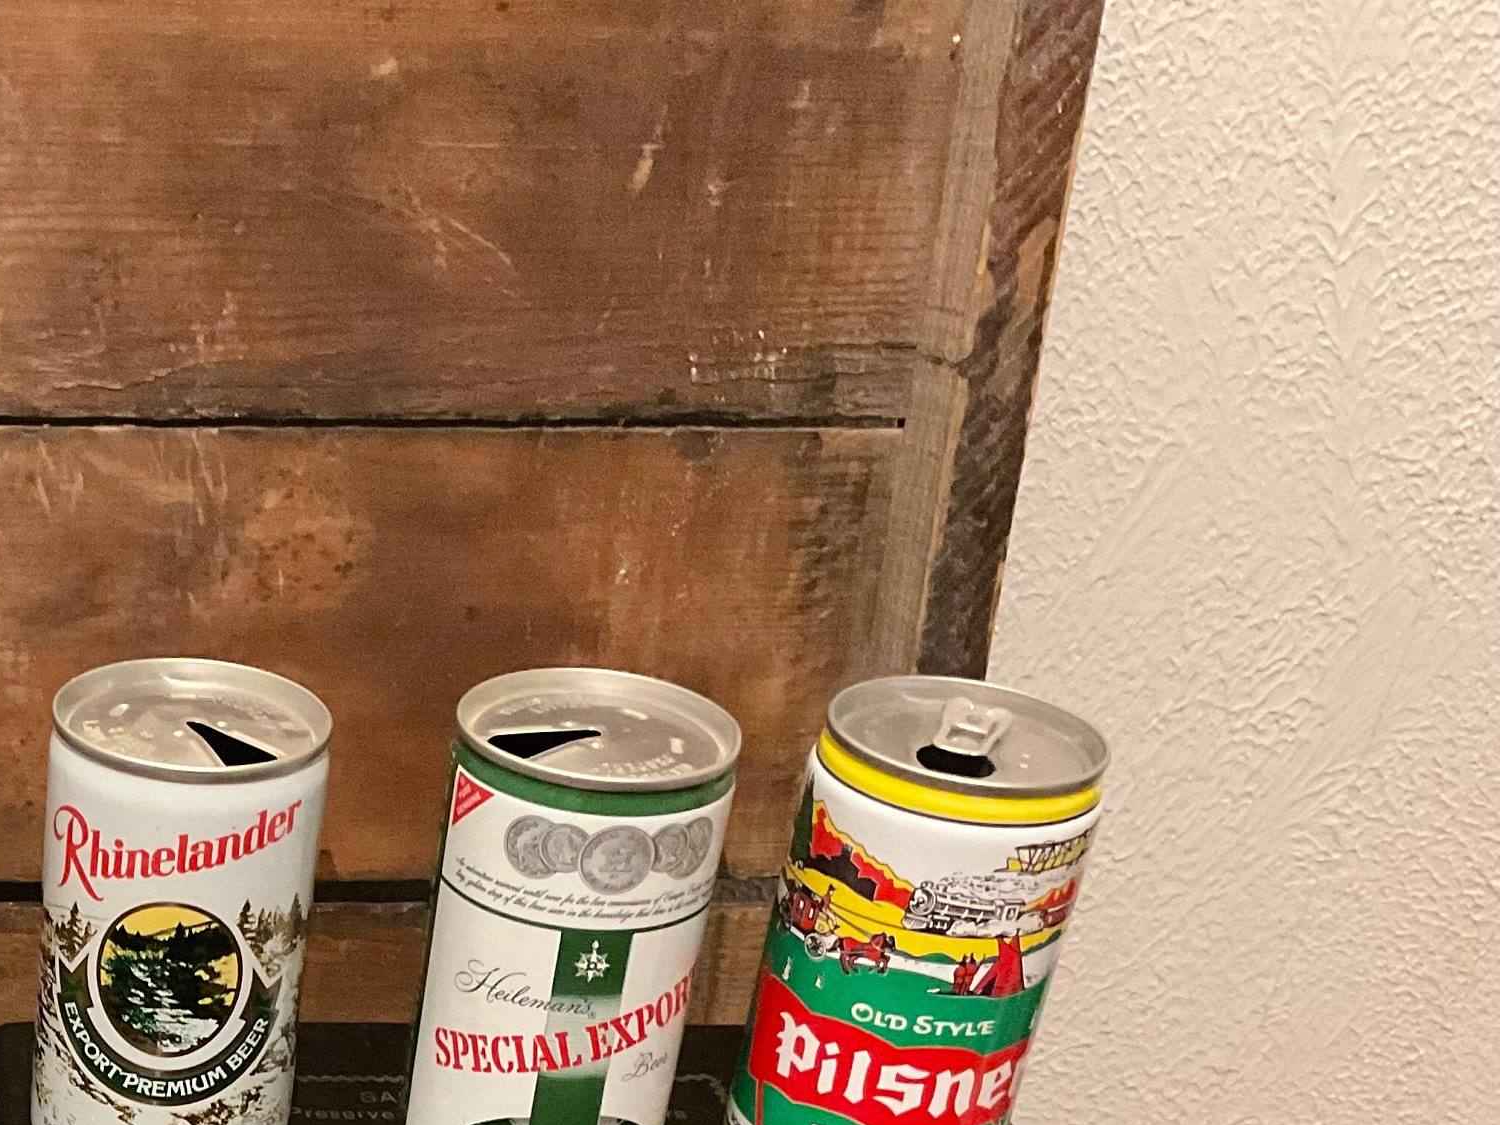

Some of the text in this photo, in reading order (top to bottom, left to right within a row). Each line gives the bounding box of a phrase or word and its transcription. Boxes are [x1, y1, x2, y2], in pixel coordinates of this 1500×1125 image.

[53, 799, 302, 902] Rhinelander
[434, 964, 697, 1074] SPECIAL EXPOR
[454, 959, 591, 1016] Heileman's
[850, 1002, 996, 1037] OLD STYLE
[64, 1001, 269, 1098] EXPORT PREMIUM BEER
